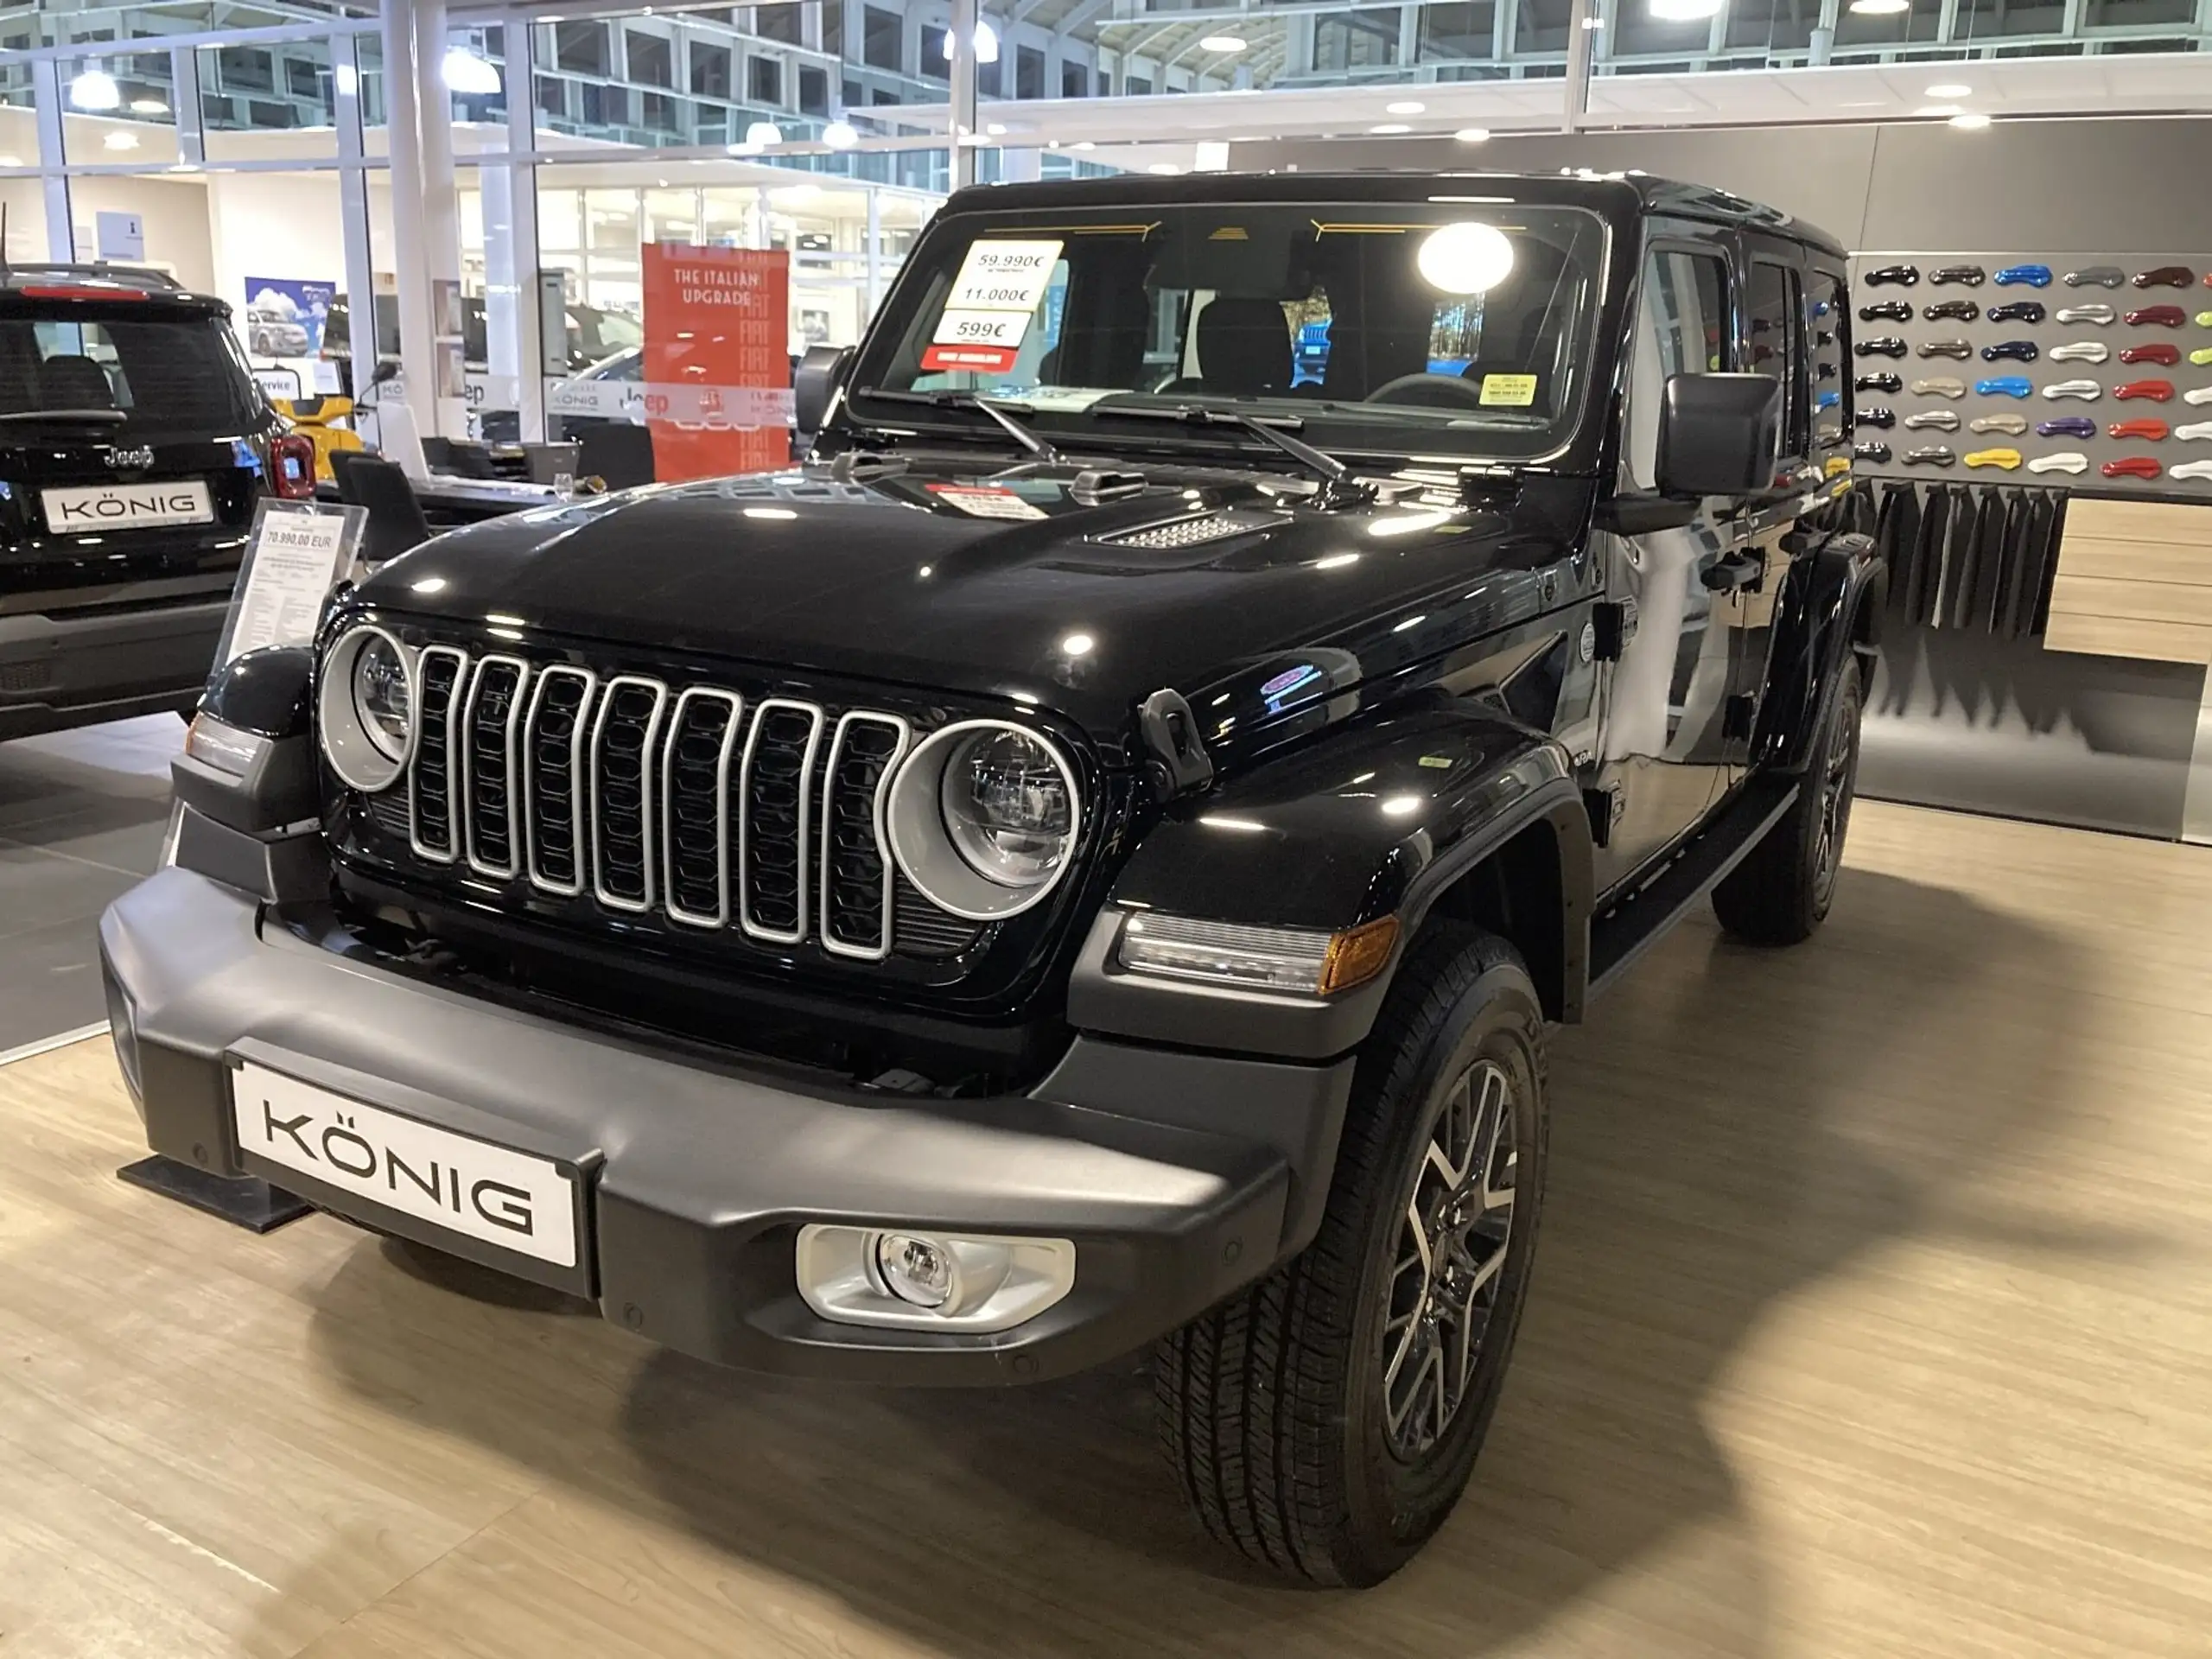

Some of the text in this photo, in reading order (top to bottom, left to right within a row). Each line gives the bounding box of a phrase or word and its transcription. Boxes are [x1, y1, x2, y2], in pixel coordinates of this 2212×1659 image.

[977, 255, 1044, 267] 59.990€
[674, 269, 700, 284] THE
[704, 270, 758, 287] ITALIAN
[683, 289, 751, 306] UPGRADE
[965, 288, 1029, 302] 11.000€
[957, 321, 1007, 338] 599€
[260, 378, 290, 390] ervice
[465, 385, 484, 405] ep
[103, 444, 155, 468] Jeep
[60, 492, 196, 520] KÖNIG
[267, 531, 333, 549] 70.990,00 EUR
[263, 1098, 534, 1236] KÖNIG
